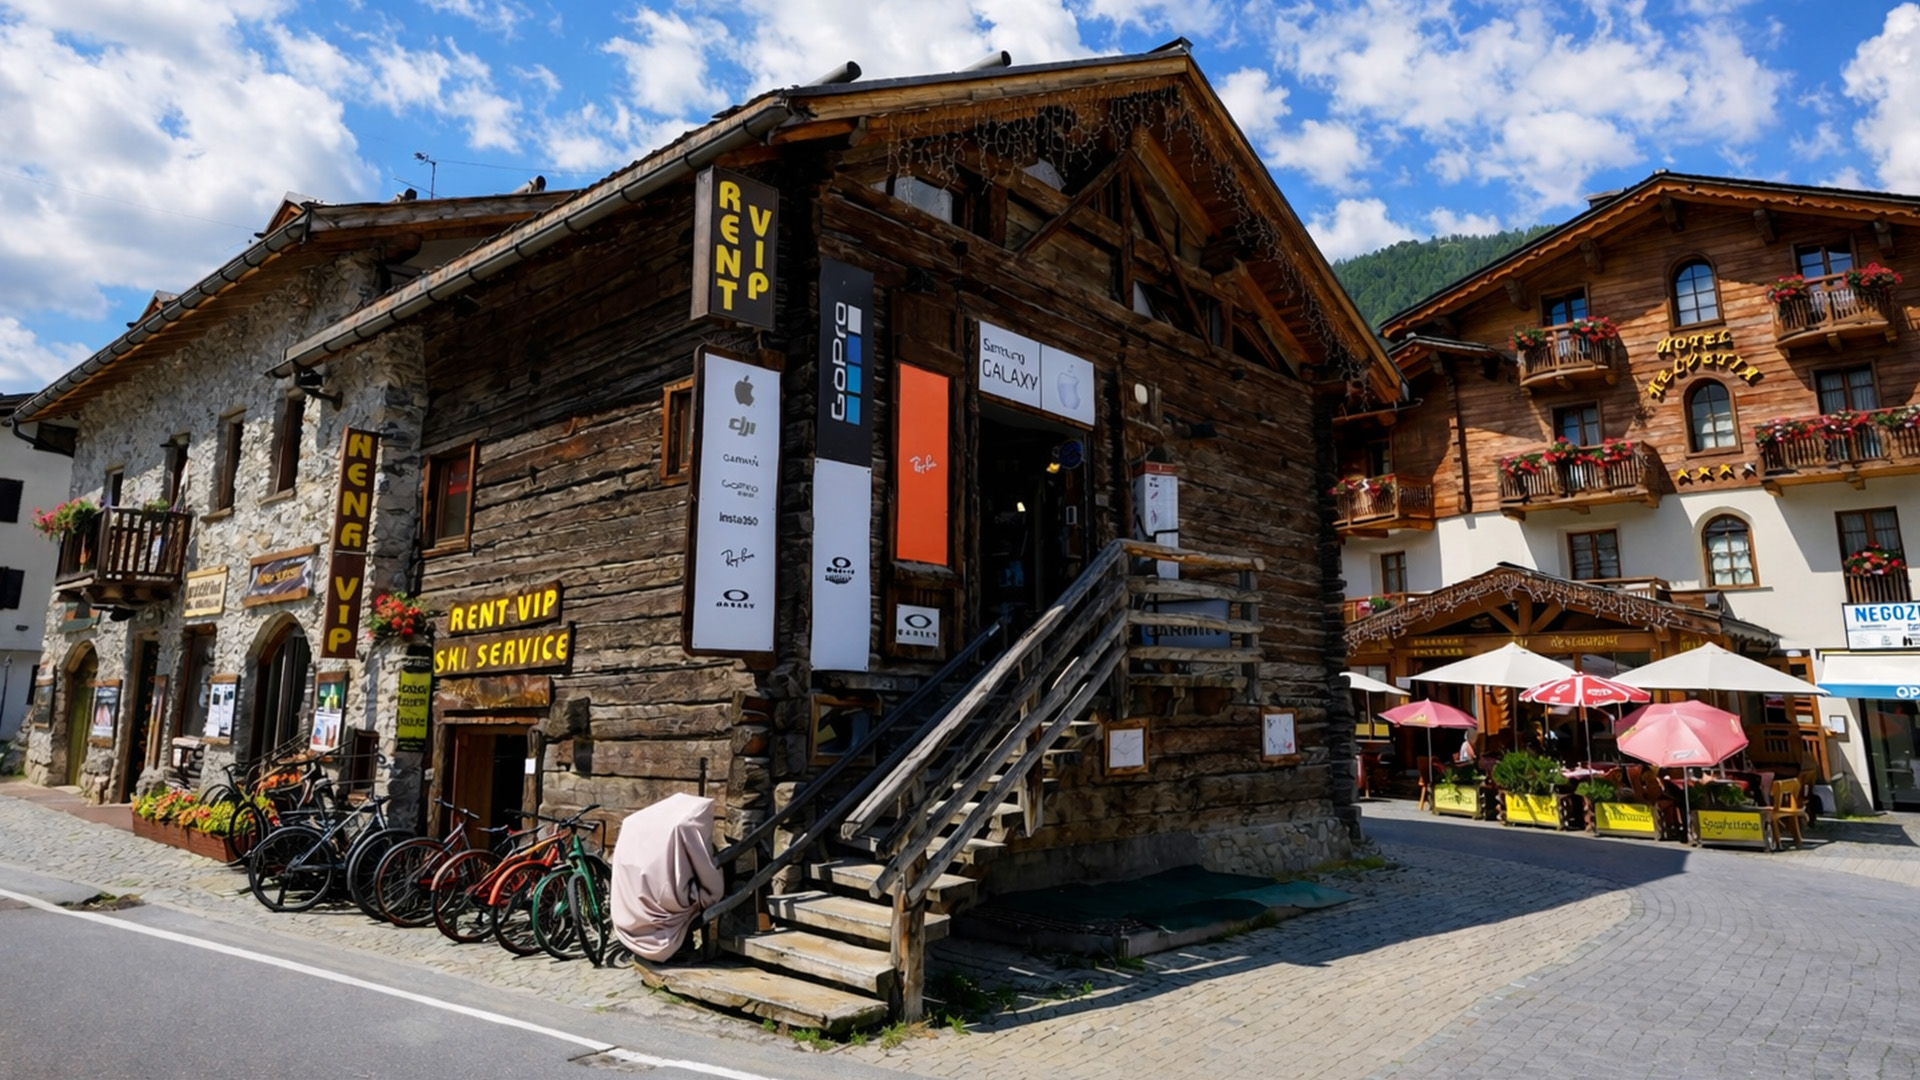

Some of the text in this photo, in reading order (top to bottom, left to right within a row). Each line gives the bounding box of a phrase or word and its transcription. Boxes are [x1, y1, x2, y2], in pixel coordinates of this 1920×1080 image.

[716, 181, 741, 311] RENT
[748, 205, 772, 300] VIP
[1657, 330, 1731, 352] HOTEL
[982, 359, 1038, 391] GALAXY
[328, 576, 359, 653] VIP
[450, 589, 557, 632] RENT VIP
[434, 633, 568, 674] SKI SERVICE
